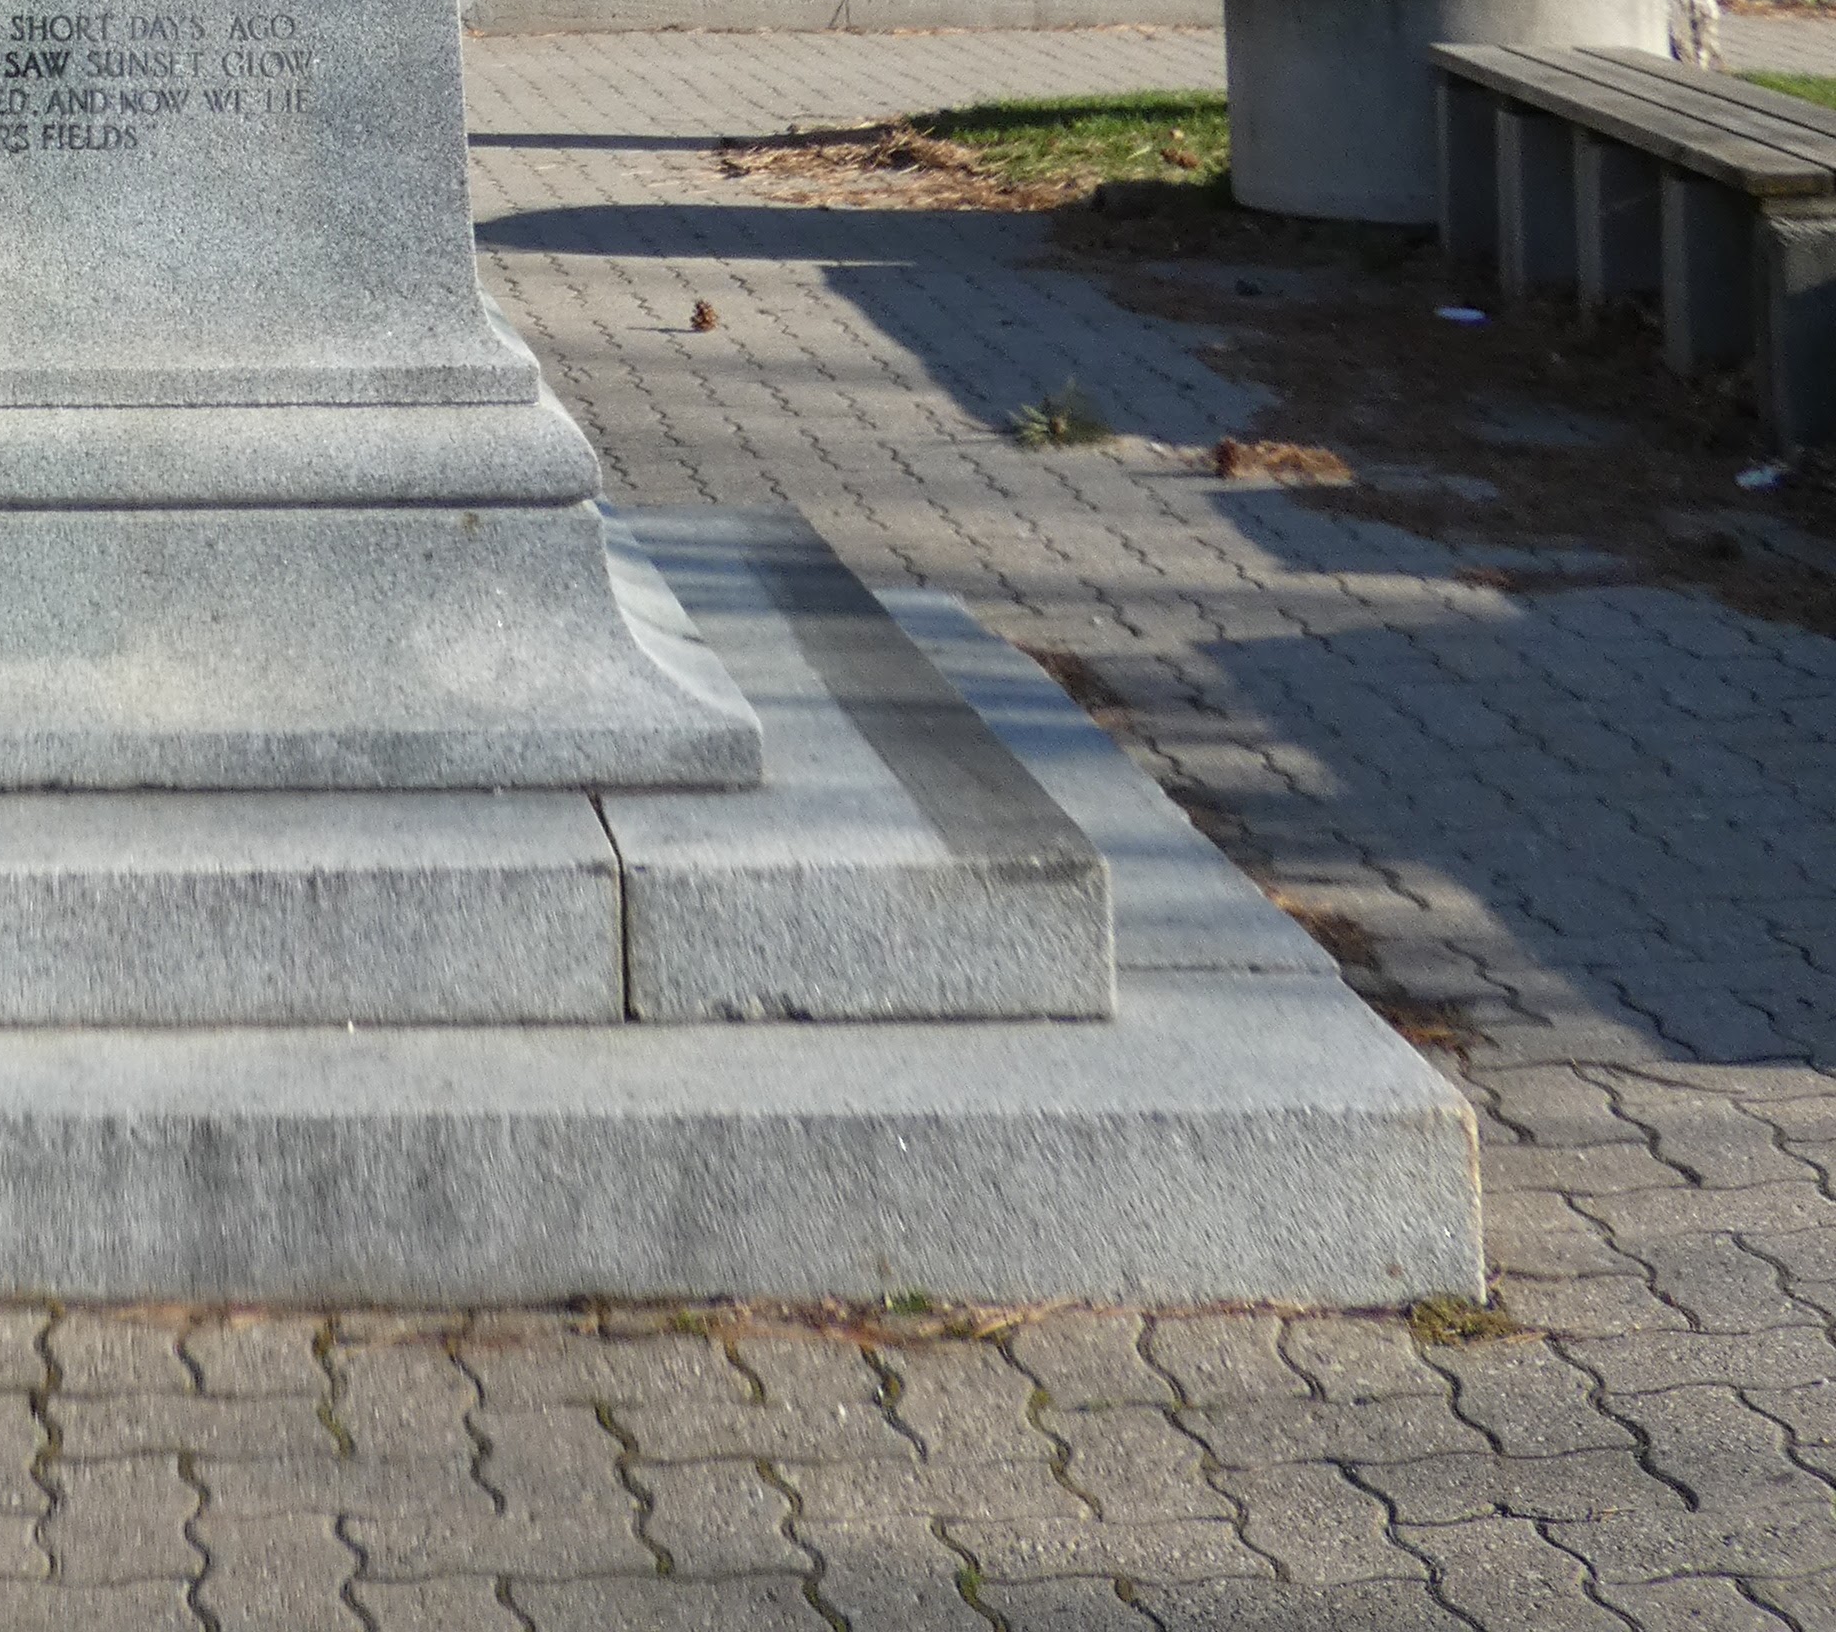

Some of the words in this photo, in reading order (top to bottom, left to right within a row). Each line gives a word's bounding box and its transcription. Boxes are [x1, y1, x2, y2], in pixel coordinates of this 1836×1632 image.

[11, 13, 115, 43] SHORT
[130, 15, 207, 42] DAYS
[229, 14, 296, 42] AGO
[4, 50, 72, 80] SAW
[86, 51, 204, 79] SUNSET
[44, 87, 111, 116] AND
[119, 88, 190, 116] NOW
[203, 88, 245, 115] WE
[265, 88, 314, 115] LIE
